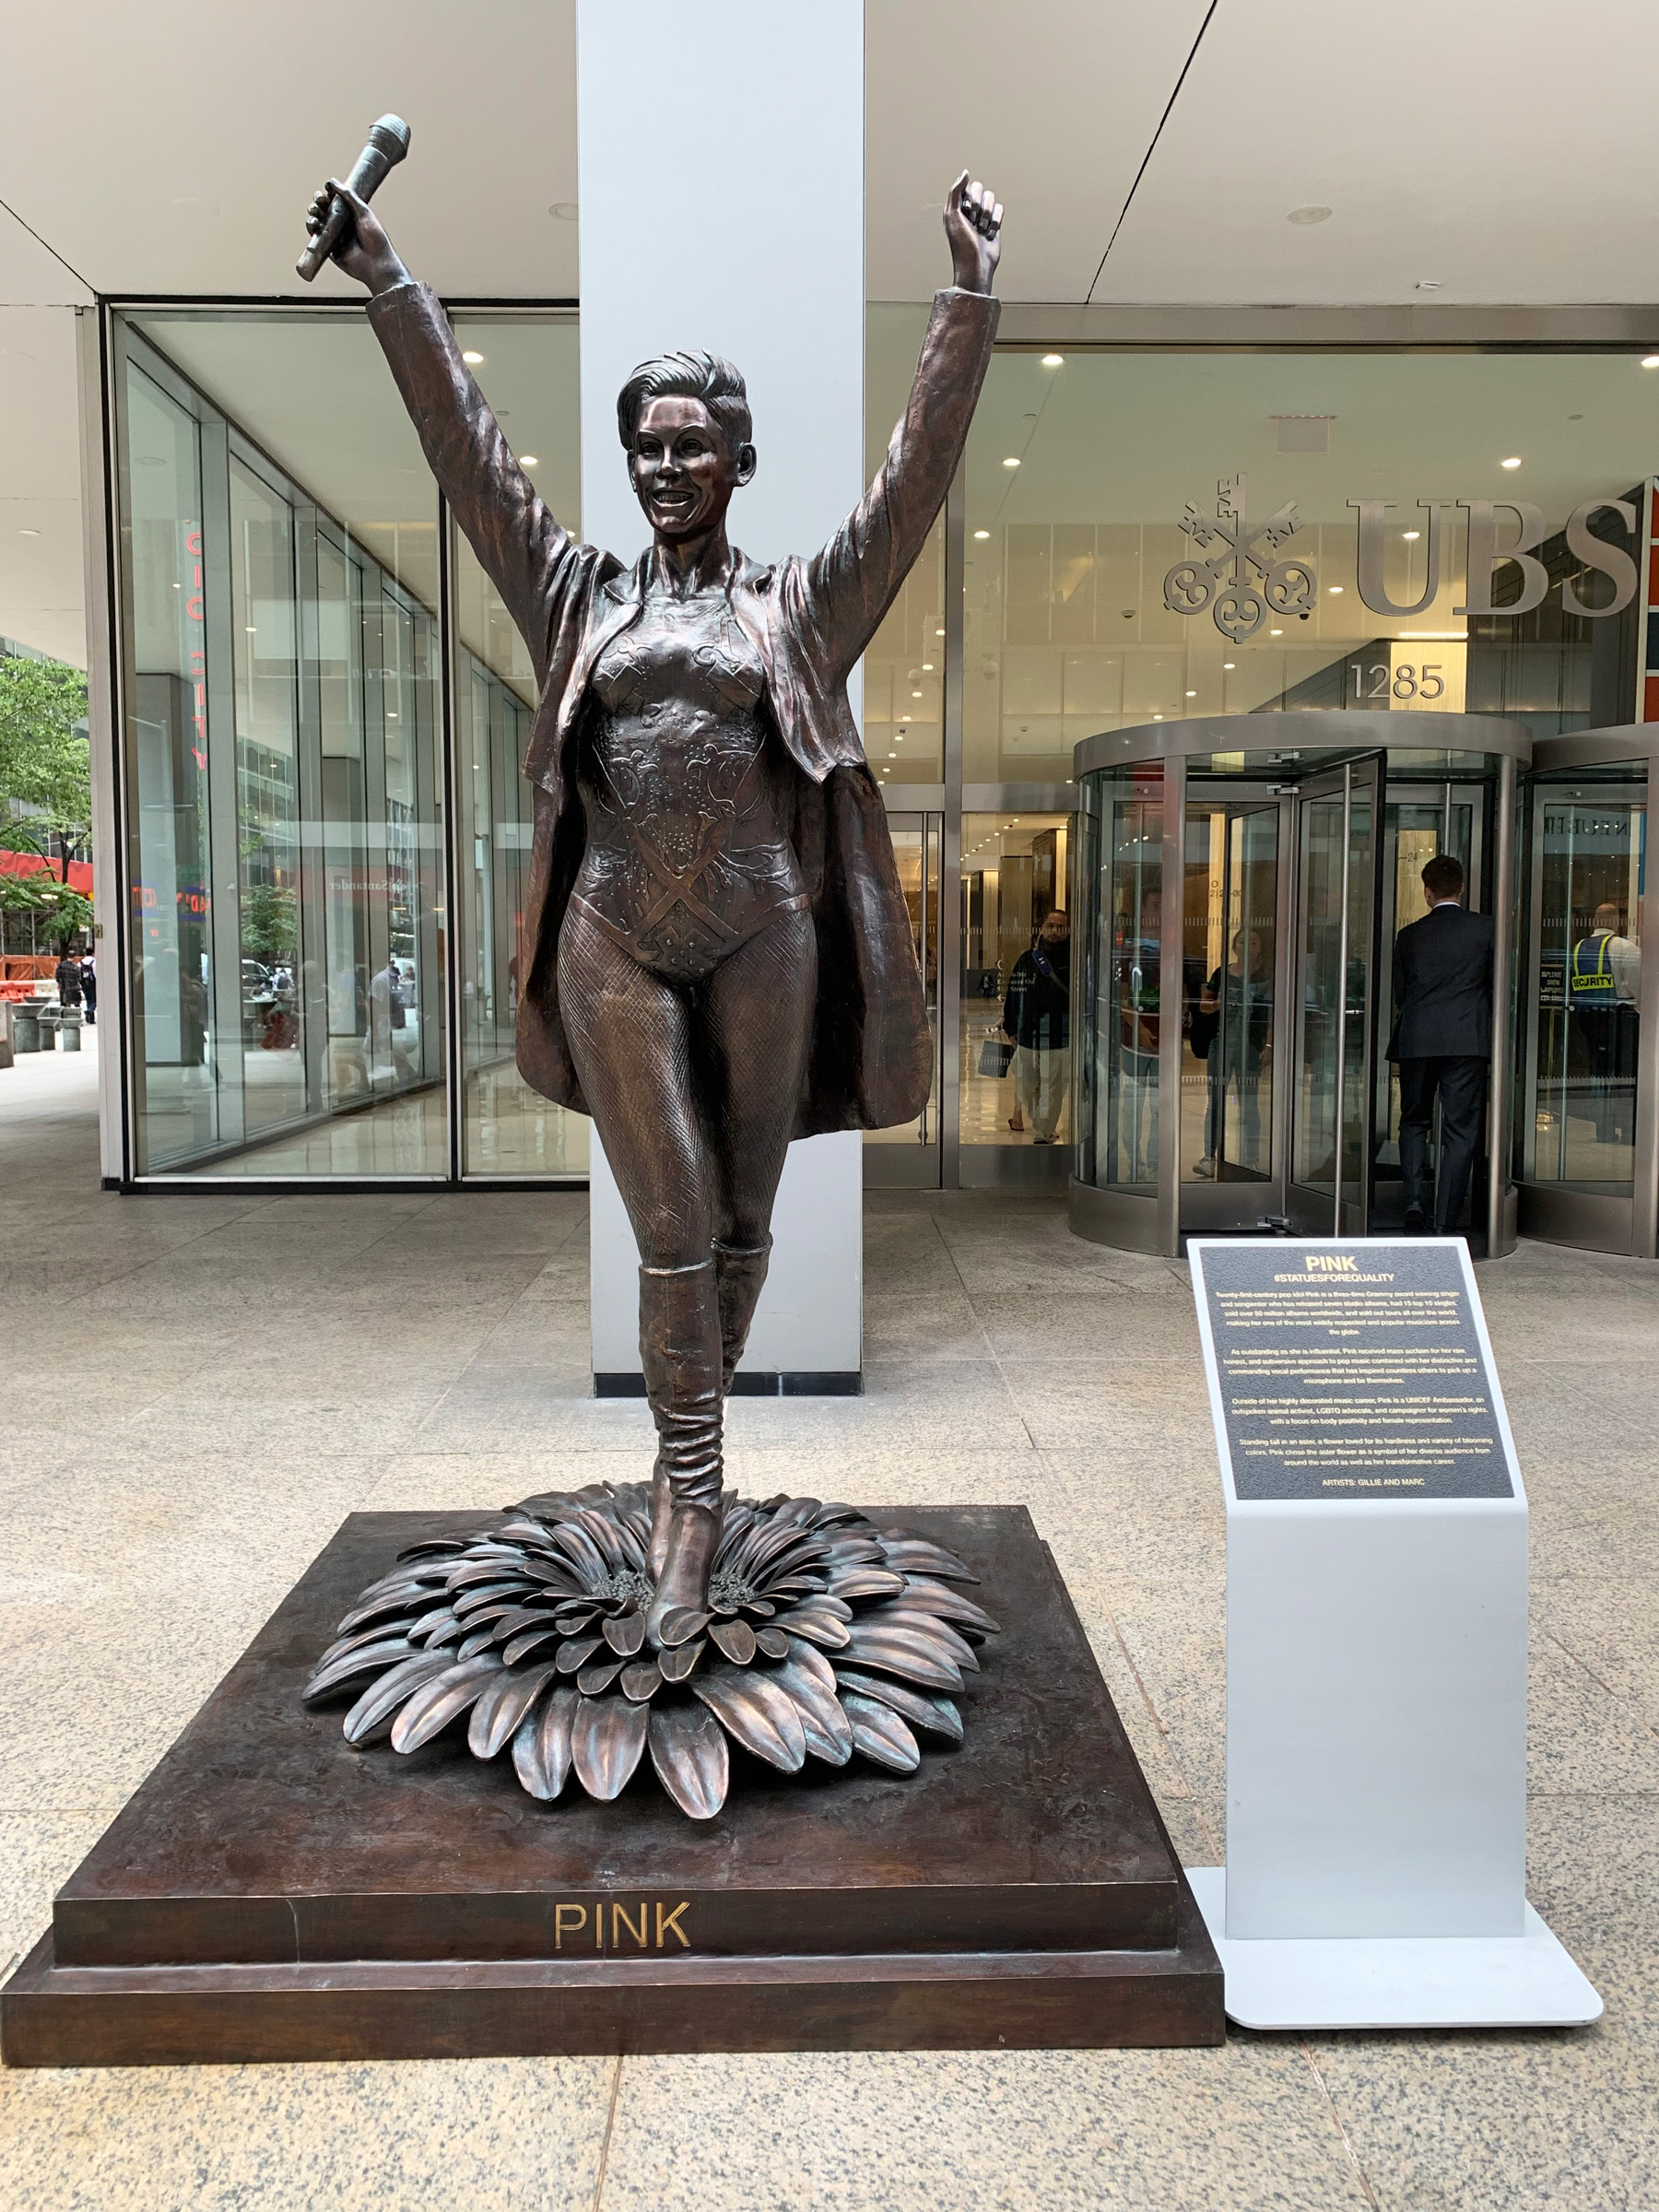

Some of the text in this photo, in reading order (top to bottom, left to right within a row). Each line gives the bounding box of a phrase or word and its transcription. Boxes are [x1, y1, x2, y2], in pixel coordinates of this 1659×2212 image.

[1346, 498, 1638, 618] UBS
[1350, 664, 1445, 700] 1285
[1304, 1255, 1359, 1272] PINK
[1274, 1273, 1394, 1283] #STATUESFOREQUALITY
[1366, 1290, 1393, 1299] Grammy
[1414, 1290, 1439, 1299] winning
[1440, 1290, 1459, 1299] singer
[1297, 1358, 1327, 1366] approach
[1228, 1368, 1270, 1376] commanding
[1289, 1368, 1330, 1376] performance
[1359, 1367, 1384, 1376] inspired
[1447, 1367, 1461, 1375] pick
[1303, 1377, 1342, 1386] microphone
[1278, 1397, 1298, 1406] highly
[1231, 1407, 1265, 1417] outspoken
[1388, 1407, 1426, 1416] campaigner
[1320, 1418, 1336, 1426] body
[1337, 1418, 1367, 1426] positivity
[1430, 1438, 1453, 1446] variety
[1462, 1438, 1493, 1446] blooming
[1373, 1448, 1397, 1456] symbol
[554, 1900, 692, 1949] PINK
